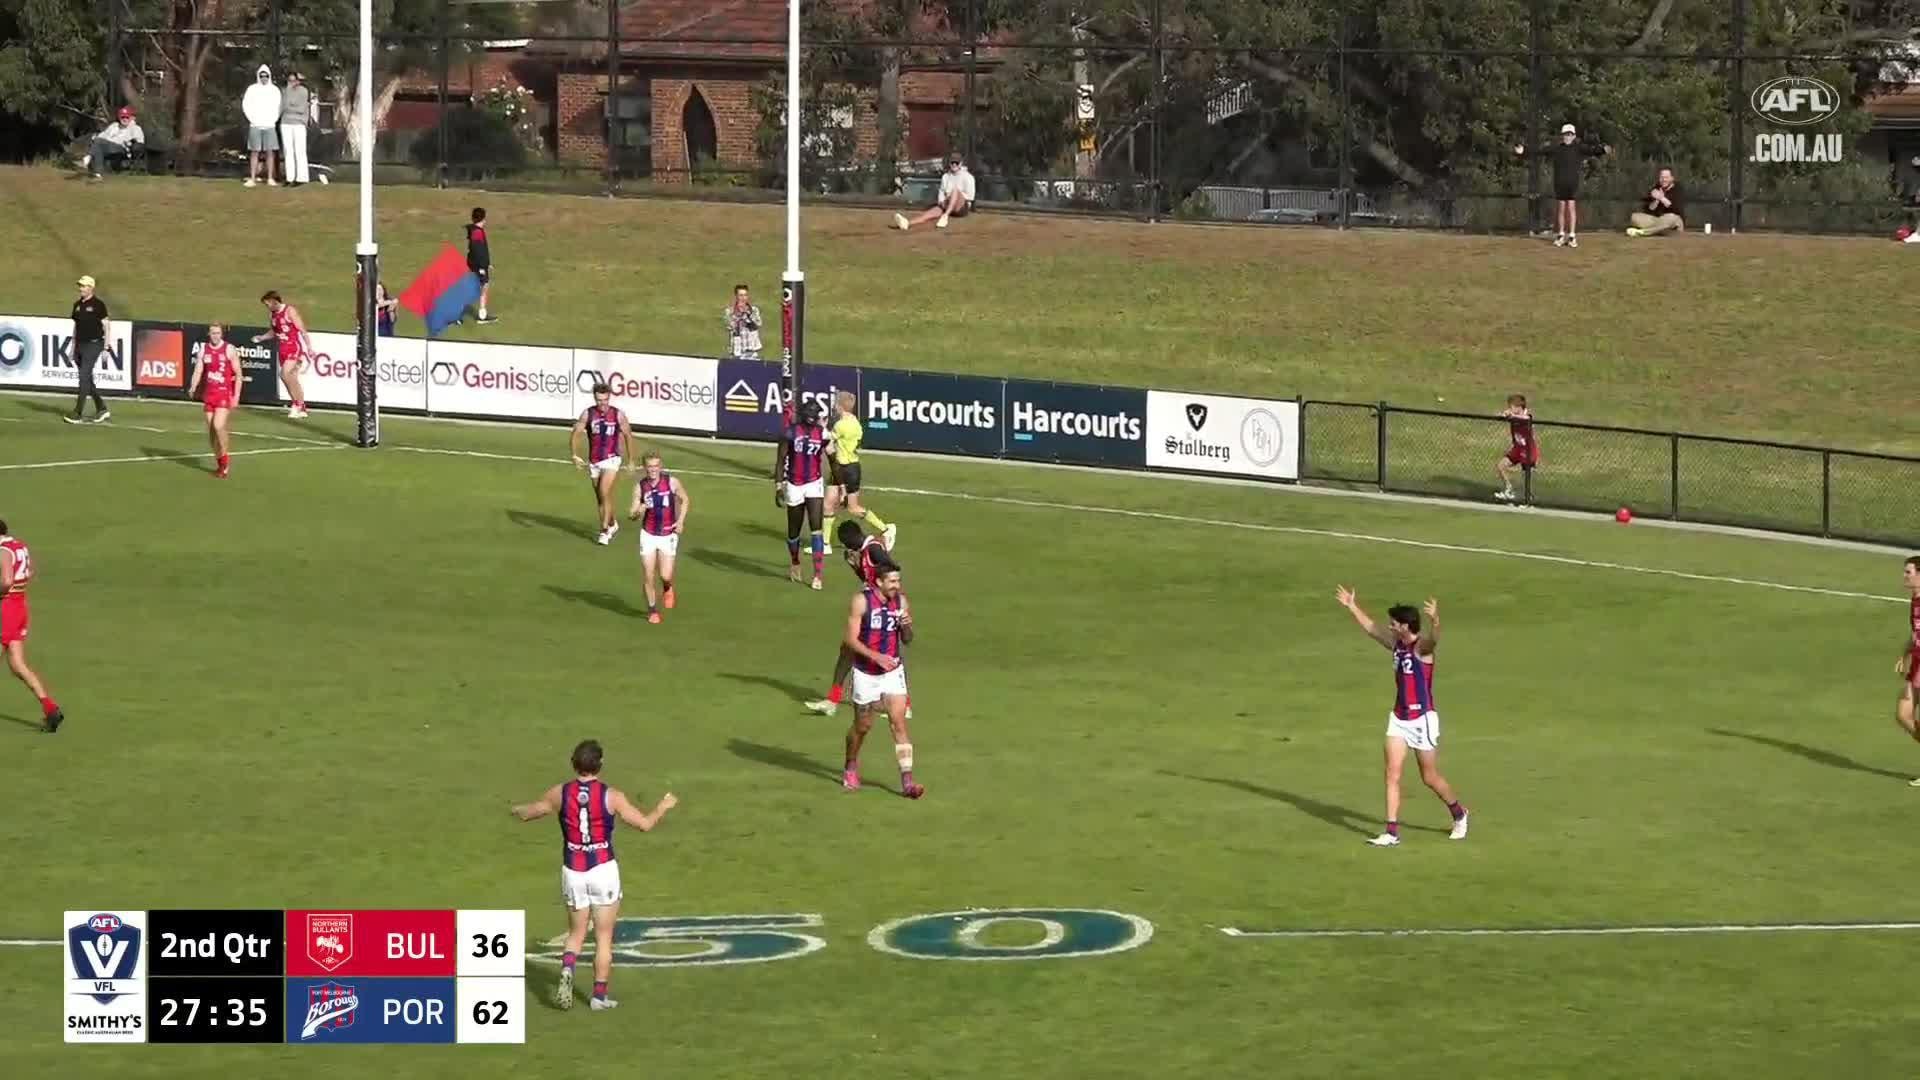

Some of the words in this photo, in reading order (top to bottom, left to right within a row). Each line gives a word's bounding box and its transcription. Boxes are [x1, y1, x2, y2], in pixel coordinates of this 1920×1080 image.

[42, 334, 124, 371] IKN
[314, 353, 424, 385] Gensteel
[140, 360, 177, 379] ADS
[463, 363, 572, 394] Genissteel
[608, 371, 715, 405] Genissteel
[763, 382, 836, 418] Asi
[868, 390, 995, 429] Harcourts
[1013, 401, 1142, 441] Harcourts
[806, 443, 821, 456] 27
[1165, 435, 1231, 463] Stolberg
